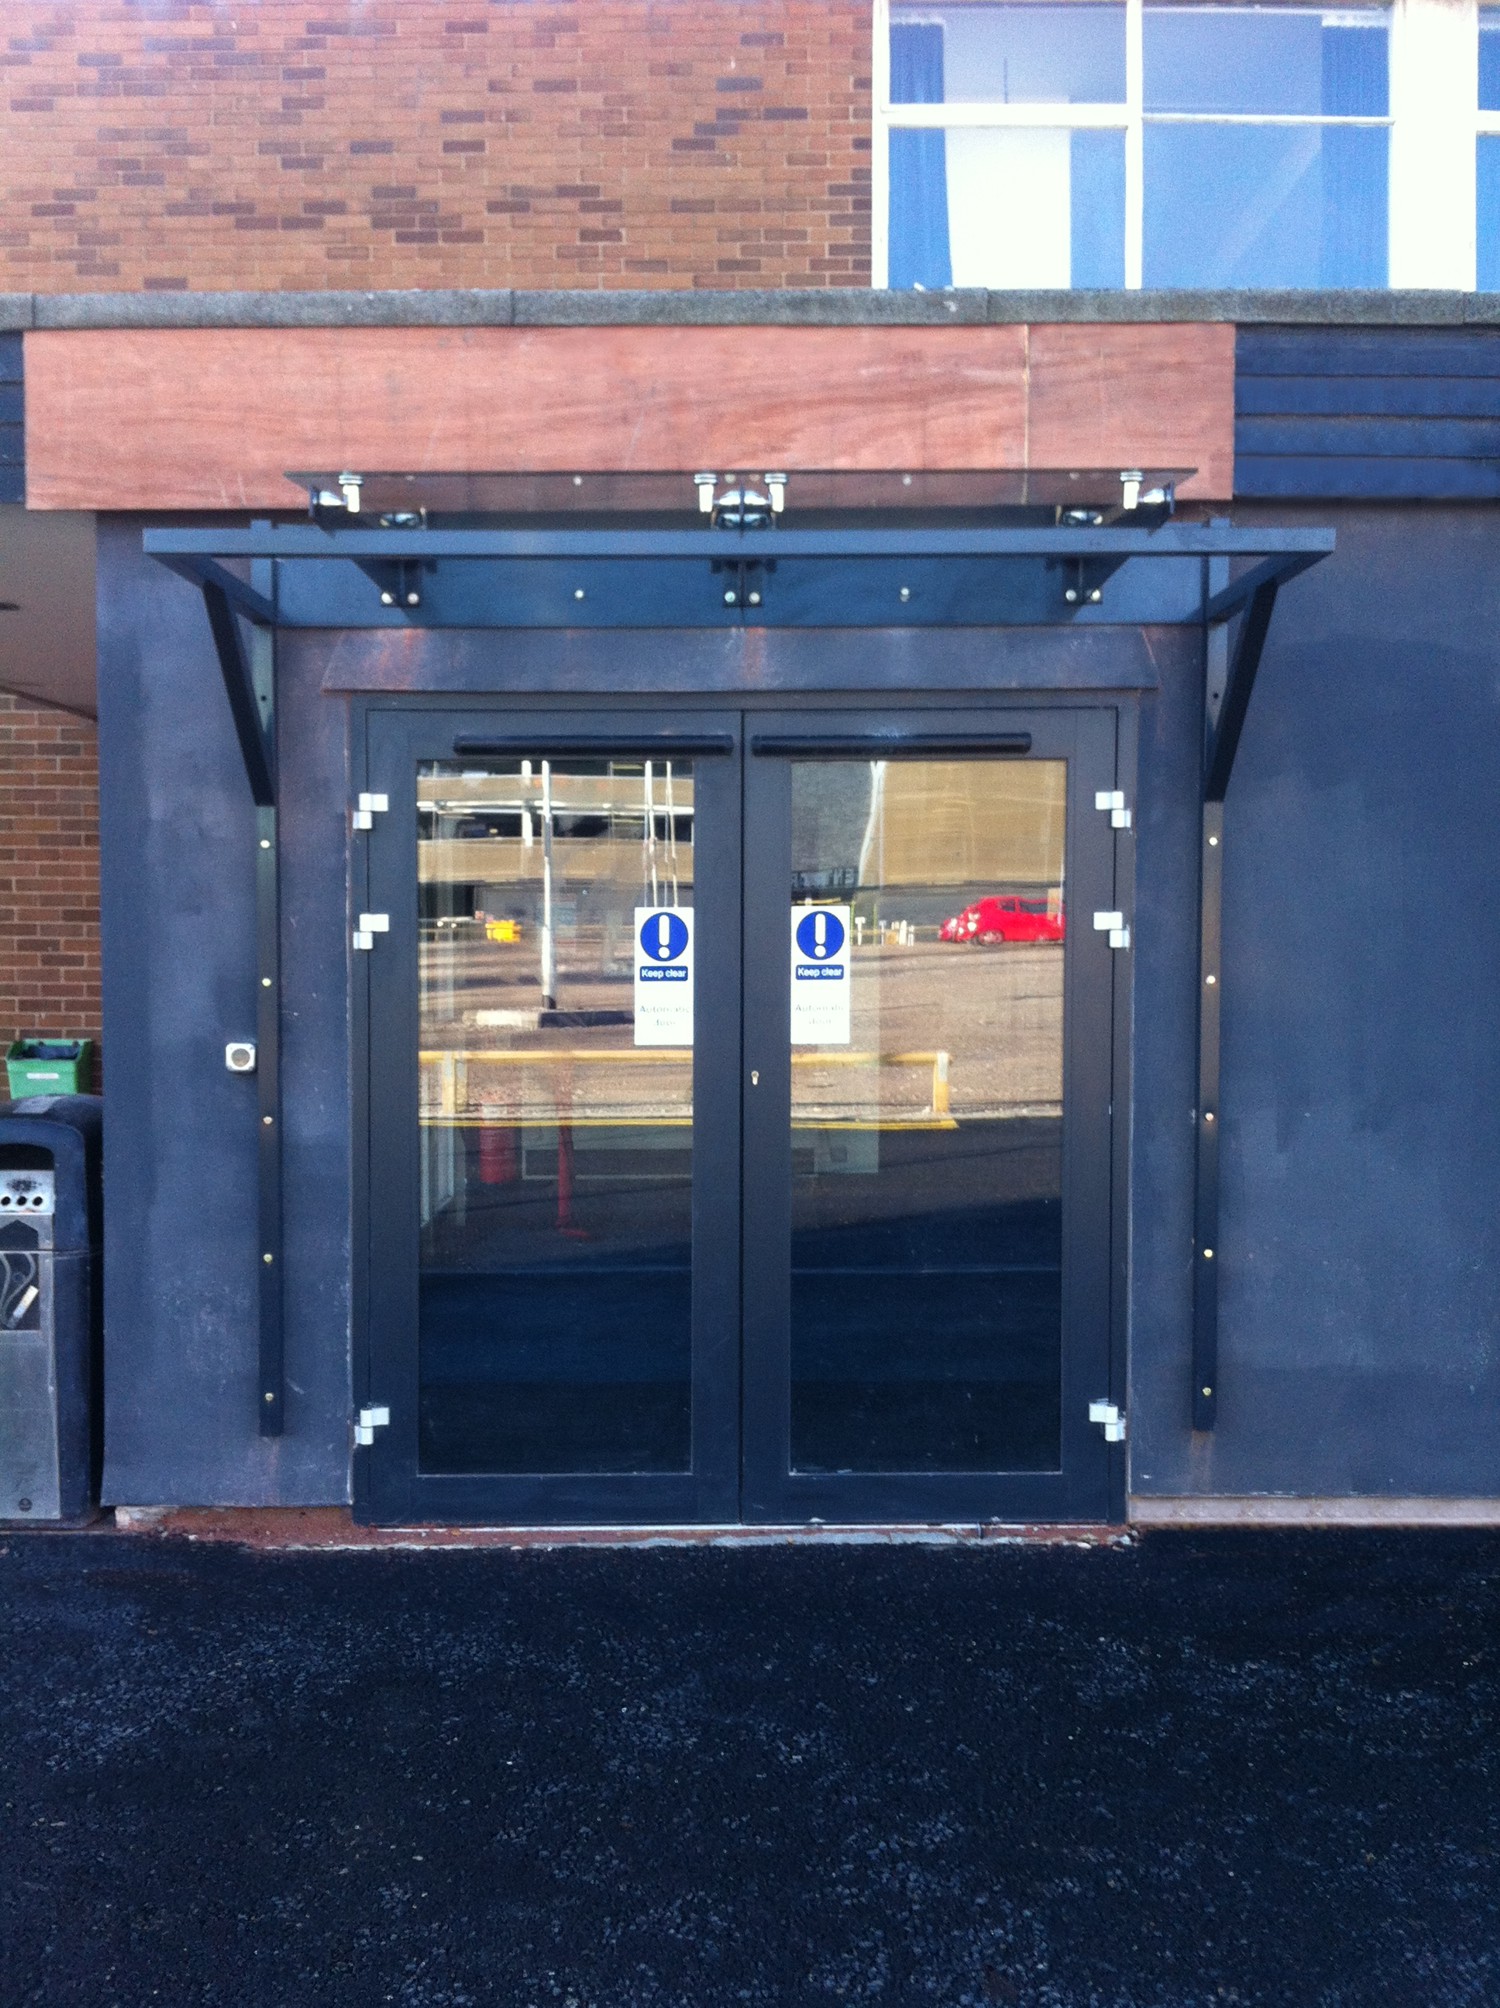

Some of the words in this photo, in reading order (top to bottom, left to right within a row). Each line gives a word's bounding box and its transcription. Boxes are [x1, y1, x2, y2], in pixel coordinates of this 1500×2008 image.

[641, 969, 664, 979] Keep
[665, 969, 687, 978] clear
[797, 967, 820, 978] Keep
[821, 967, 843, 977] clear
